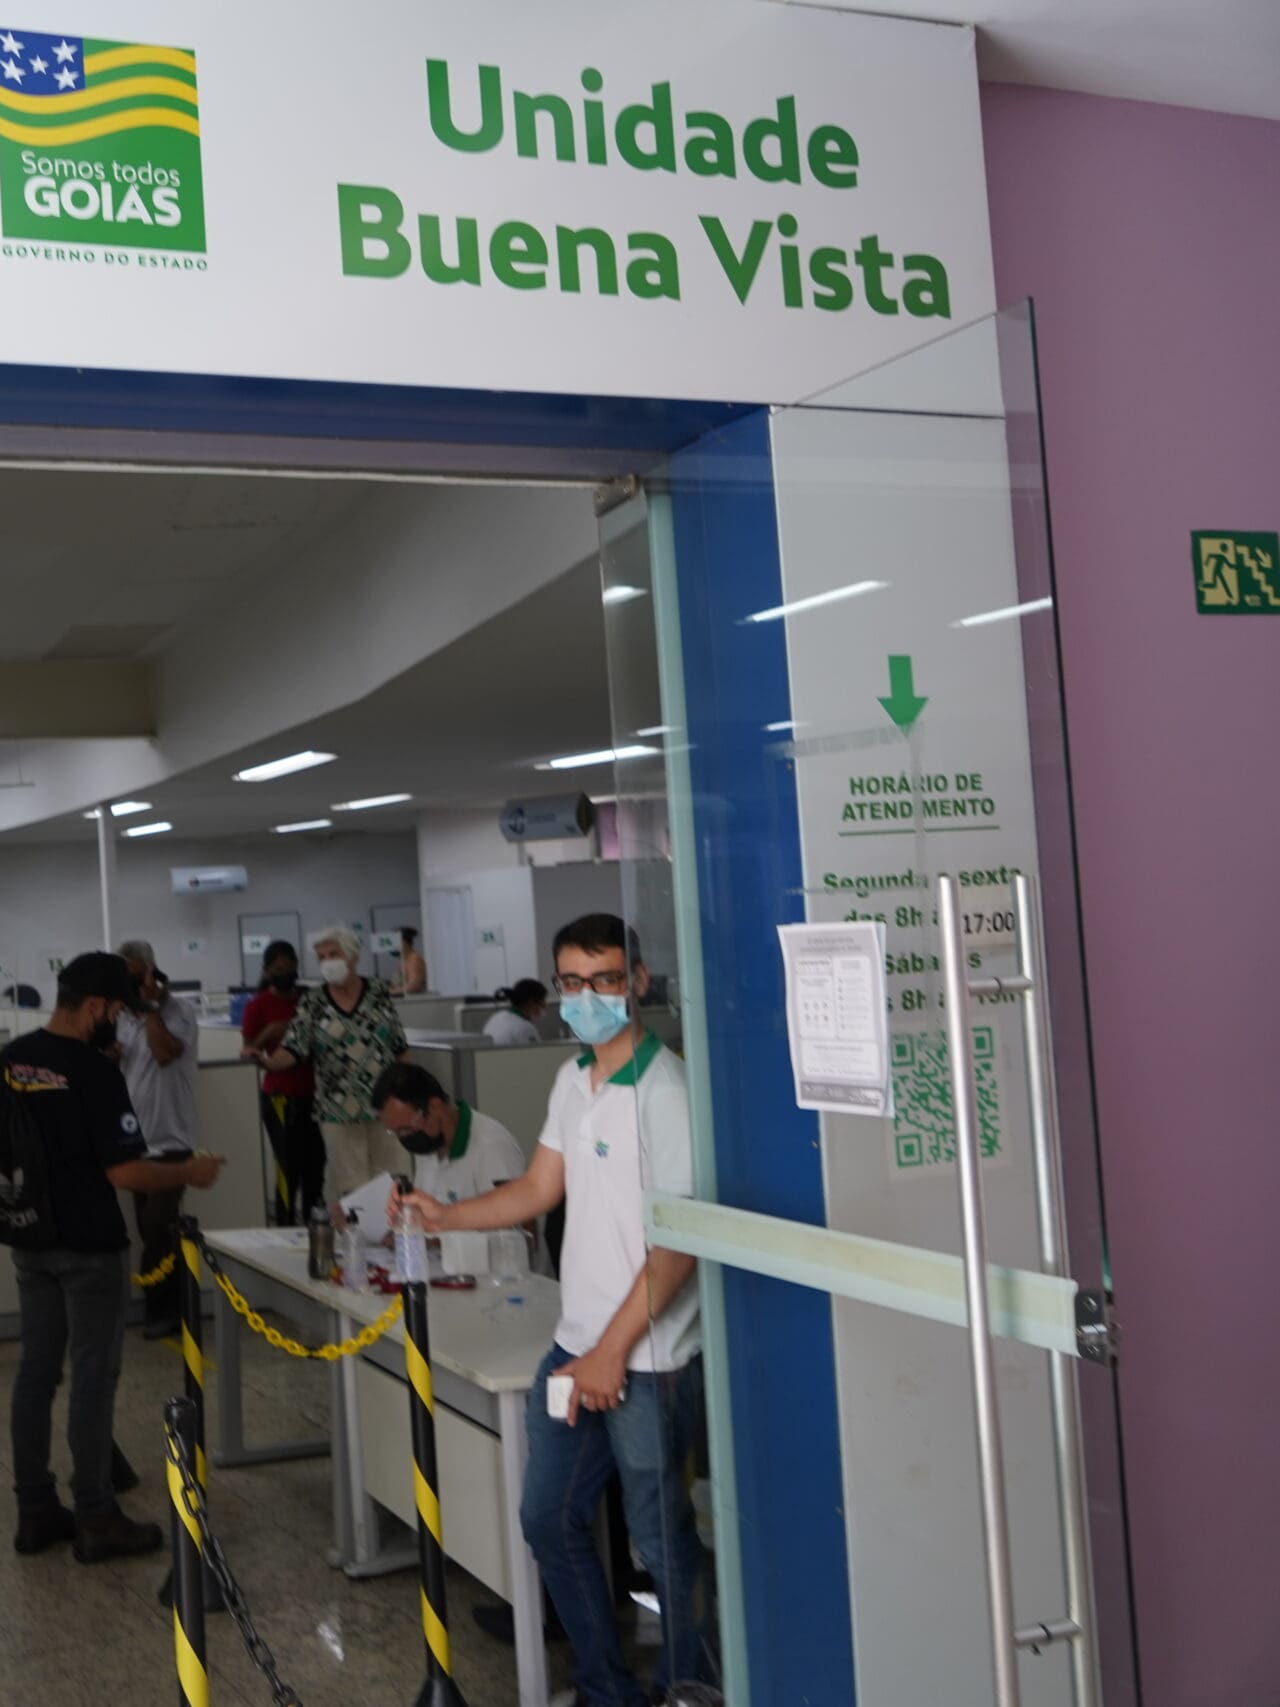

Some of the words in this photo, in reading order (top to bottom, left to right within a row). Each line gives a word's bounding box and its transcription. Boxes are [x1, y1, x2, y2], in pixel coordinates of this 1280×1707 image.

[425, 56, 860, 189] Unidade
[20, 150, 107, 182] Somos
[111, 160, 182, 188] todos
[22, 177, 183, 228] GOIÁS
[1, 244, 96, 265] GOVERNO
[104, 251, 130, 266] DO
[137, 254, 209, 272] ESTADO
[336, 181, 681, 302] Buena
[697, 211, 952, 320] Vista
[955, 773, 983, 792] DE
[842, 798, 996, 822] ATENDMENTO
[895, 905, 923, 928] 8h
[963, 911, 1016, 935] 17:00
